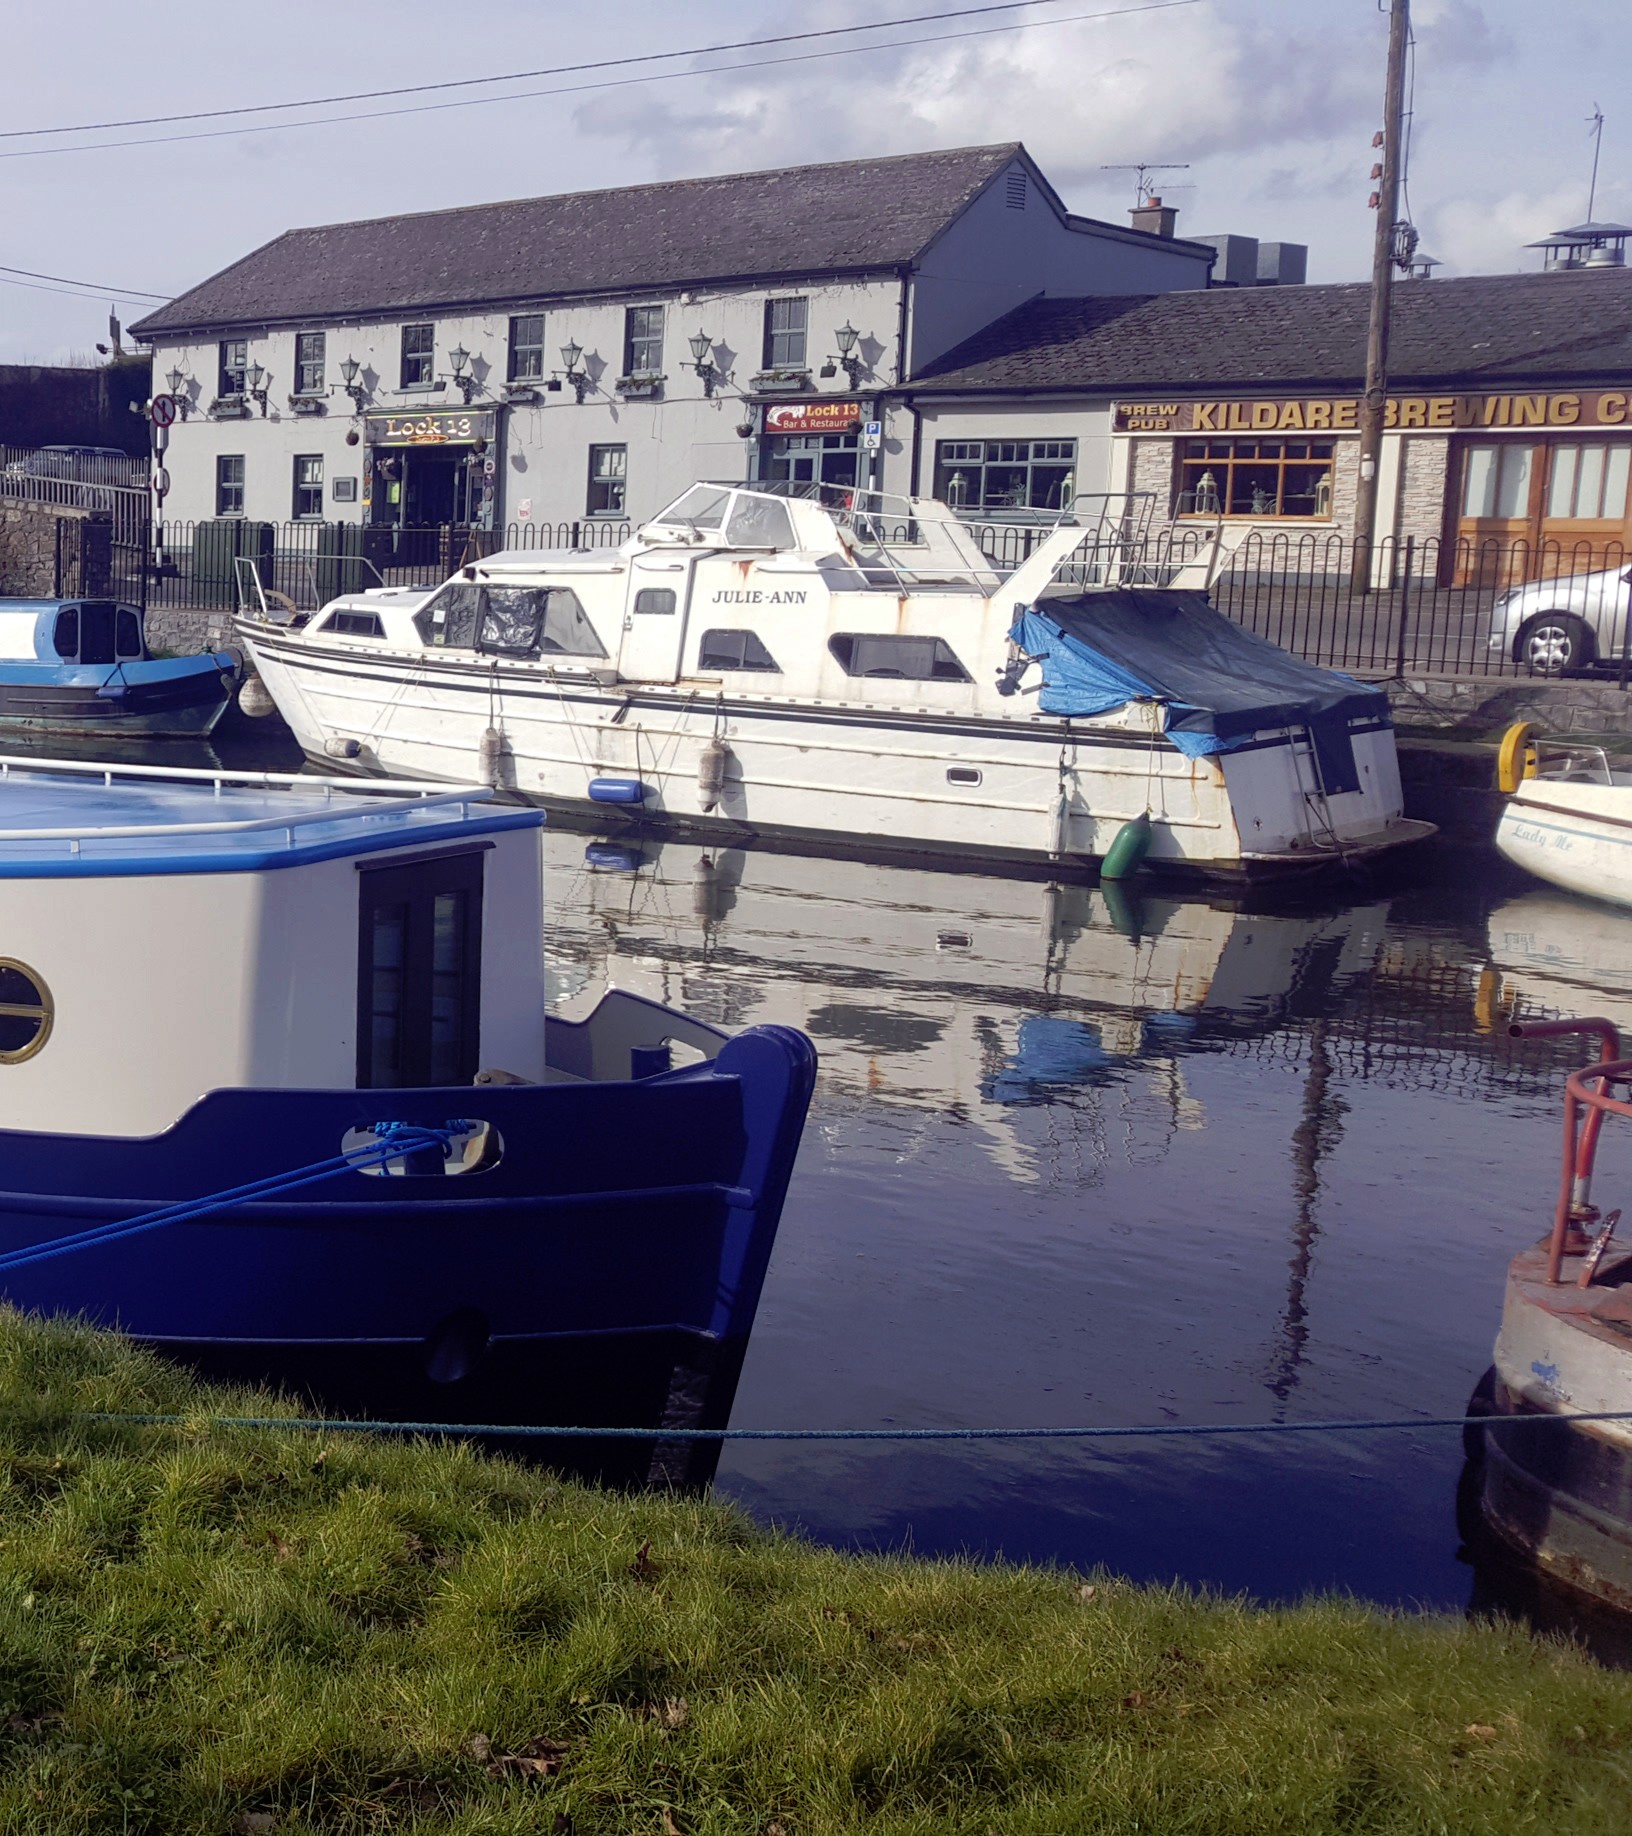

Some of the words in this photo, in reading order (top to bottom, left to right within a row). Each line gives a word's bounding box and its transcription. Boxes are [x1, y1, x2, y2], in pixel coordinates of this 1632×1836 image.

[806, 404, 839, 417] Lock
[843, 403, 859, 416] 13
[1120, 404, 1178, 416] BREW
[1192, 400, 1358, 430] KILDARE
[1383, 394, 1581, 427] BREWING
[1596, 393, 1632, 424] C
[386, 416, 441, 436] Lock
[447, 418, 471, 437] 13
[783, 419, 797, 428] Bar
[800, 419, 807, 428] &
[810, 419, 849, 428] Restaura
[869, 424, 876, 433] P
[1128, 418, 1168, 430] PUB
[711, 590, 807, 604] JULIE-ANN
[1512, 824, 1547, 847] Lady
